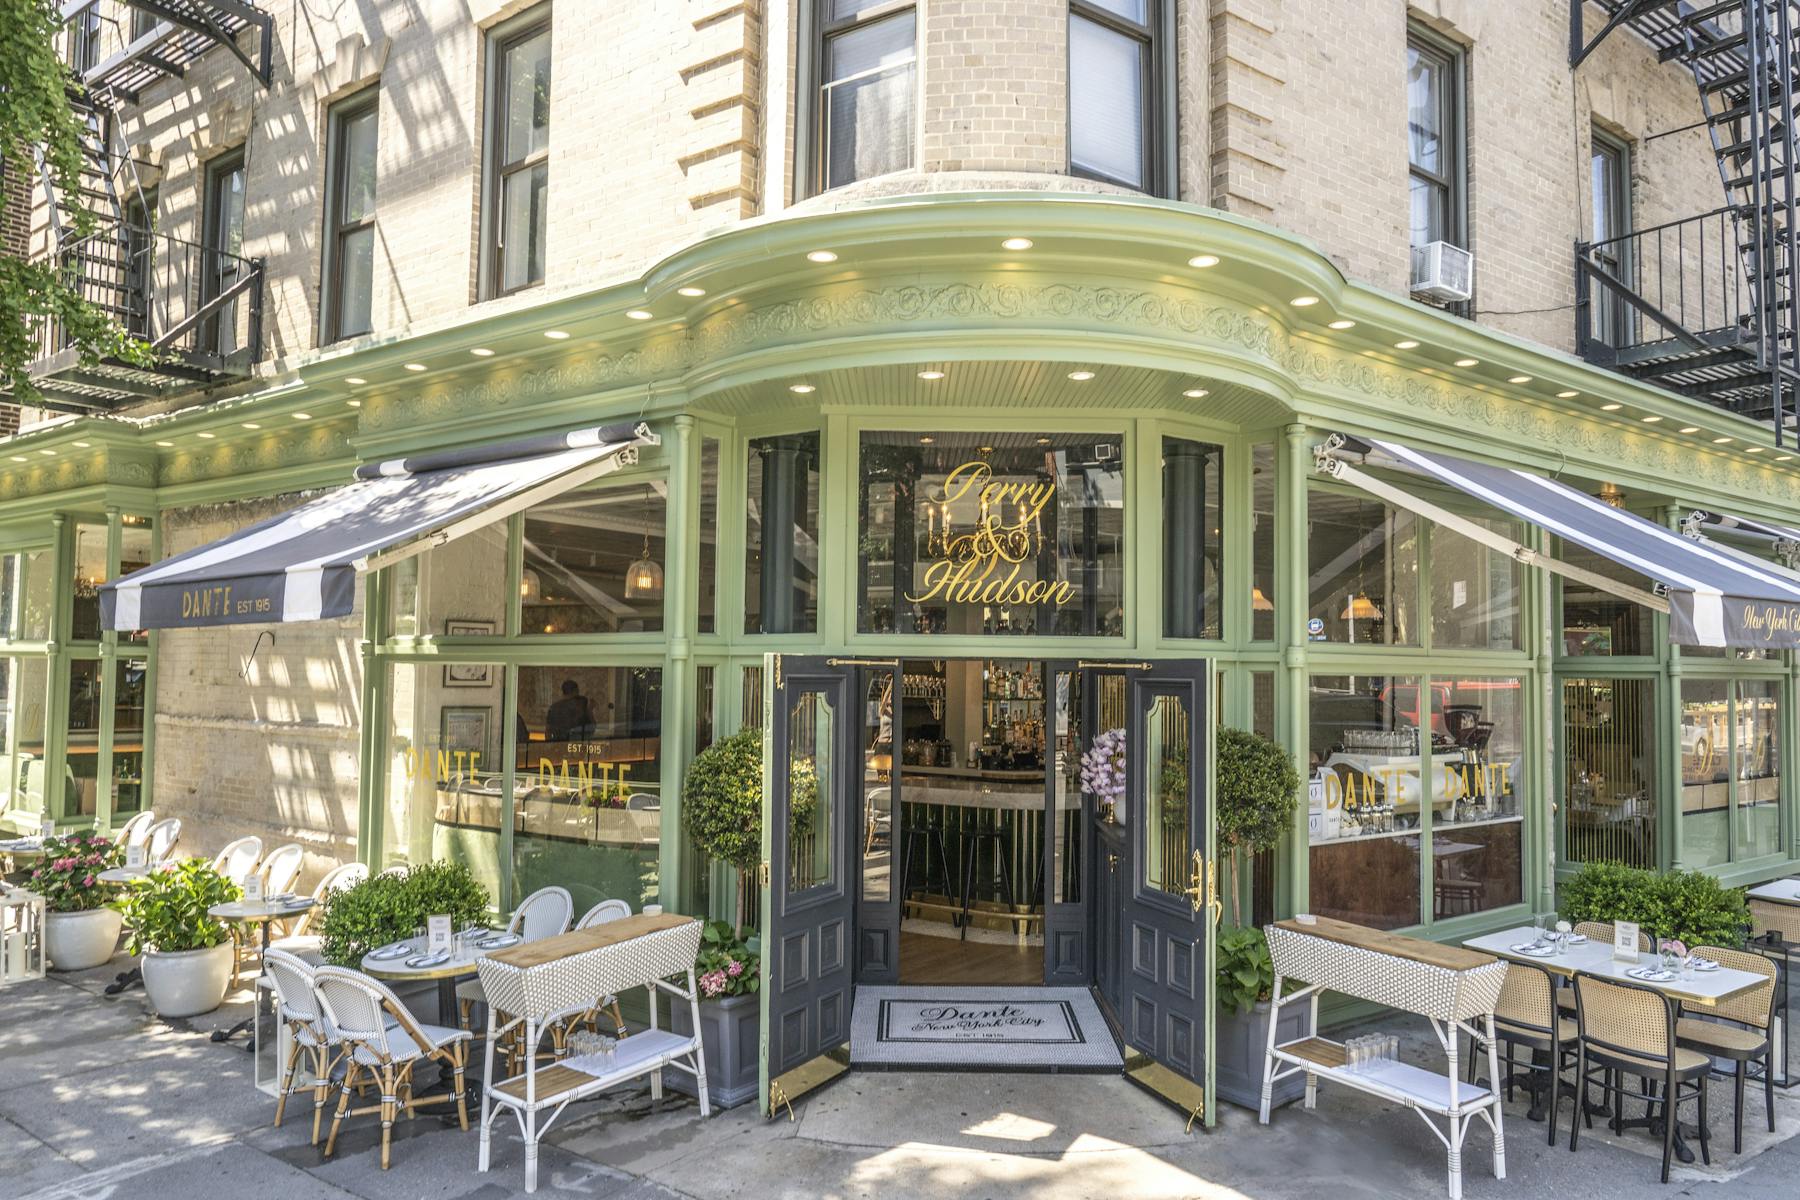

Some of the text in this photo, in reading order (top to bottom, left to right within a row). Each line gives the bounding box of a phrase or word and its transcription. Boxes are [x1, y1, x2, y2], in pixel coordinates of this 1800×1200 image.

[930, 461, 1055, 530] Perry
[904, 560, 1076, 605] Hudson
[182, 586, 271, 619] DANTE EST 1915
[1743, 605, 1764, 630] New
[1764, 606, 1788, 641] York
[405, 746, 481, 786] DANTE
[567, 743, 602, 755] EST. 1915
[539, 757, 632, 801] DANTE
[1325, 769, 1409, 810] DANTE
[1444, 761, 1513, 799] DANTE
[911, 1016, 1047, 1032] New York City
[919, 1005, 1024, 1022] Dante
